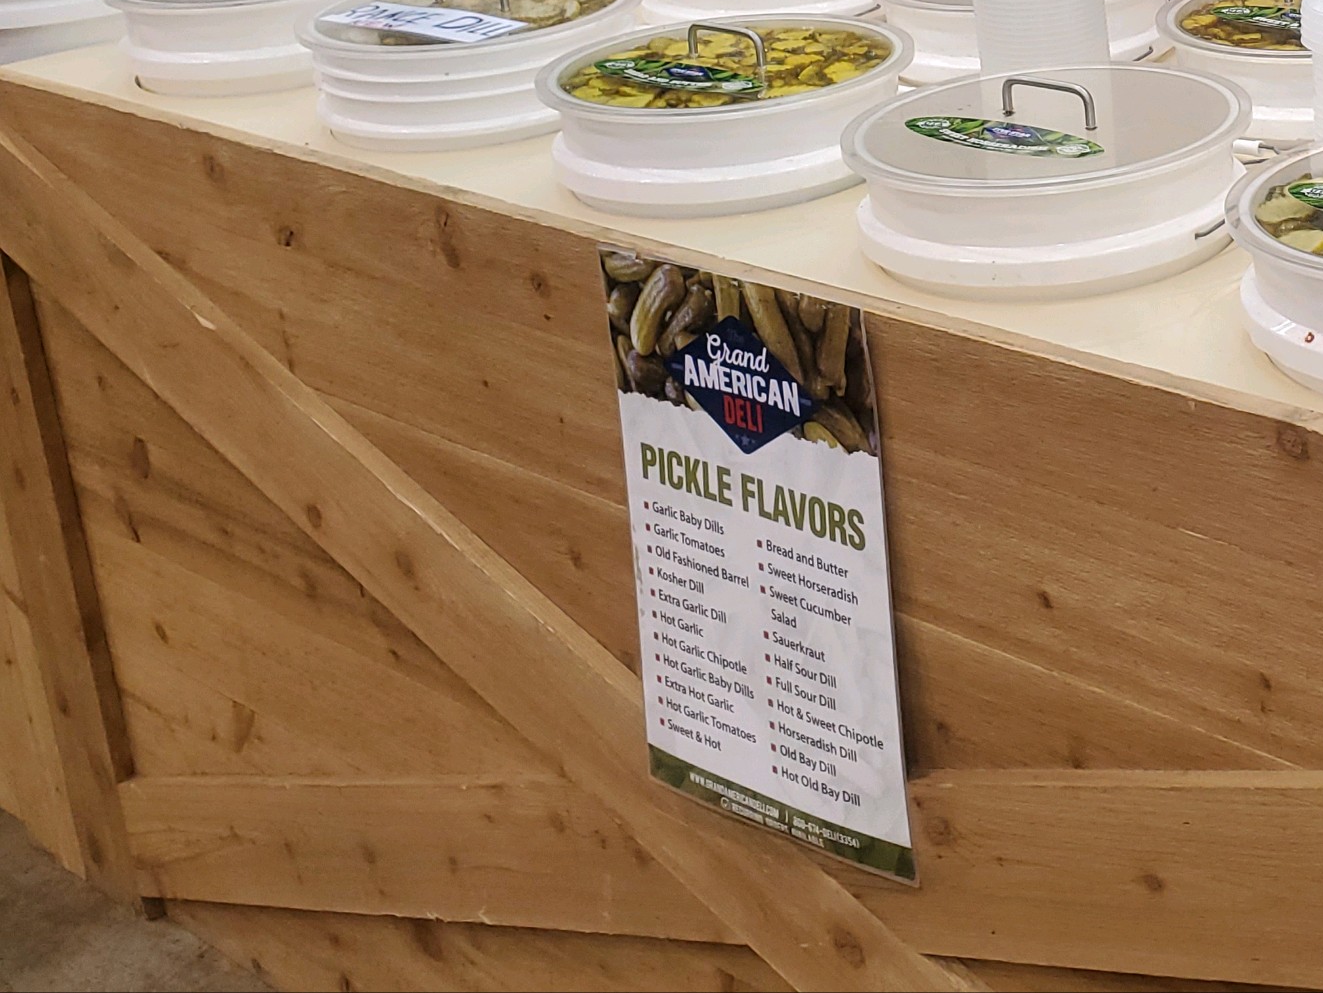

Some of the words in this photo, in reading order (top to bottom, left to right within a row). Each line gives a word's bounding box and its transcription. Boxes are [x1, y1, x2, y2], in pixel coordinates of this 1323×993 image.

[705, 332, 769, 374] Grand
[684, 354, 801, 417] AMERICAN
[723, 394, 764, 433] DELI
[640, 442, 732, 507] PICKLE
[740, 473, 866, 551] FLAVORS
[652, 501, 678, 520] Garlic
[680, 510, 702, 530] Baby
[704, 518, 724, 535] Dills
[654, 523, 679, 542] Garlic
[680, 532, 725, 558] Tomatoes
[766, 539, 794, 560] Bread
[796, 551, 814, 567] and
[817, 557, 848, 579] Butter
[655, 545, 671, 561] Old
[673, 552, 719, 578] Fashioned
[721, 568, 750, 588] Barrel
[657, 567, 687, 587] Kosher
[689, 579, 704, 594] Dill
[768, 563, 797, 584] Sweet
[798, 573, 859, 605] Horseradish
[658, 589, 680, 607] Extra
[682, 598, 709, 618] Garlic
[711, 608, 727, 624] Dill
[660, 611, 676, 627] Hot
[677, 619, 704, 637] Garlic
[769, 586, 798, 607] Sweet
[800, 598, 851, 626] Cucumber
[771, 609, 797, 628] Salad
[662, 632, 678, 649] Hot
[679, 640, 705, 660] Garlic
[706, 650, 748, 675] Chipotle
[772, 631, 825, 663] Sauerkraut
[663, 654, 679, 670] Hot
[680, 662, 707, 681] Garlic
[708, 672, 732, 693] Baby
[734, 682, 755, 700] Dills
[774, 654, 793, 672] Half
[795, 663, 817, 681] Sour
[819, 672, 837, 688] Dill
[664, 675, 687, 695] Extra
[688, 686, 705, 703] Hot
[707, 694, 734, 713] Garlic
[775, 676, 792, 694] Full
[794, 685, 817, 703] Sour
[819, 694, 836, 710] Dill
[666, 696, 682, 714] Hot
[683, 705, 710, 725] Garlic
[710, 715, 757, 743] Tomatoes
[667, 718, 694, 740] Sweet
[696, 731, 703, 743] &
[704, 734, 722, 751] Hot
[777, 699, 794, 717] Hot
[796, 708, 803, 720] &
[806, 711, 836, 734] Sweet
[838, 724, 884, 750] Chipotle
[778, 721, 837, 756] Horseradish
[840, 746, 857, 763] Dill
[780, 745, 796, 761] Old
[799, 752, 817, 771] Bay
[819, 760, 836, 777] Dill
[781, 766, 799, 784] Hot
[801, 775, 819, 791] Old
[821, 782, 840, 802] Bay
[842, 790, 861, 807] Dill
